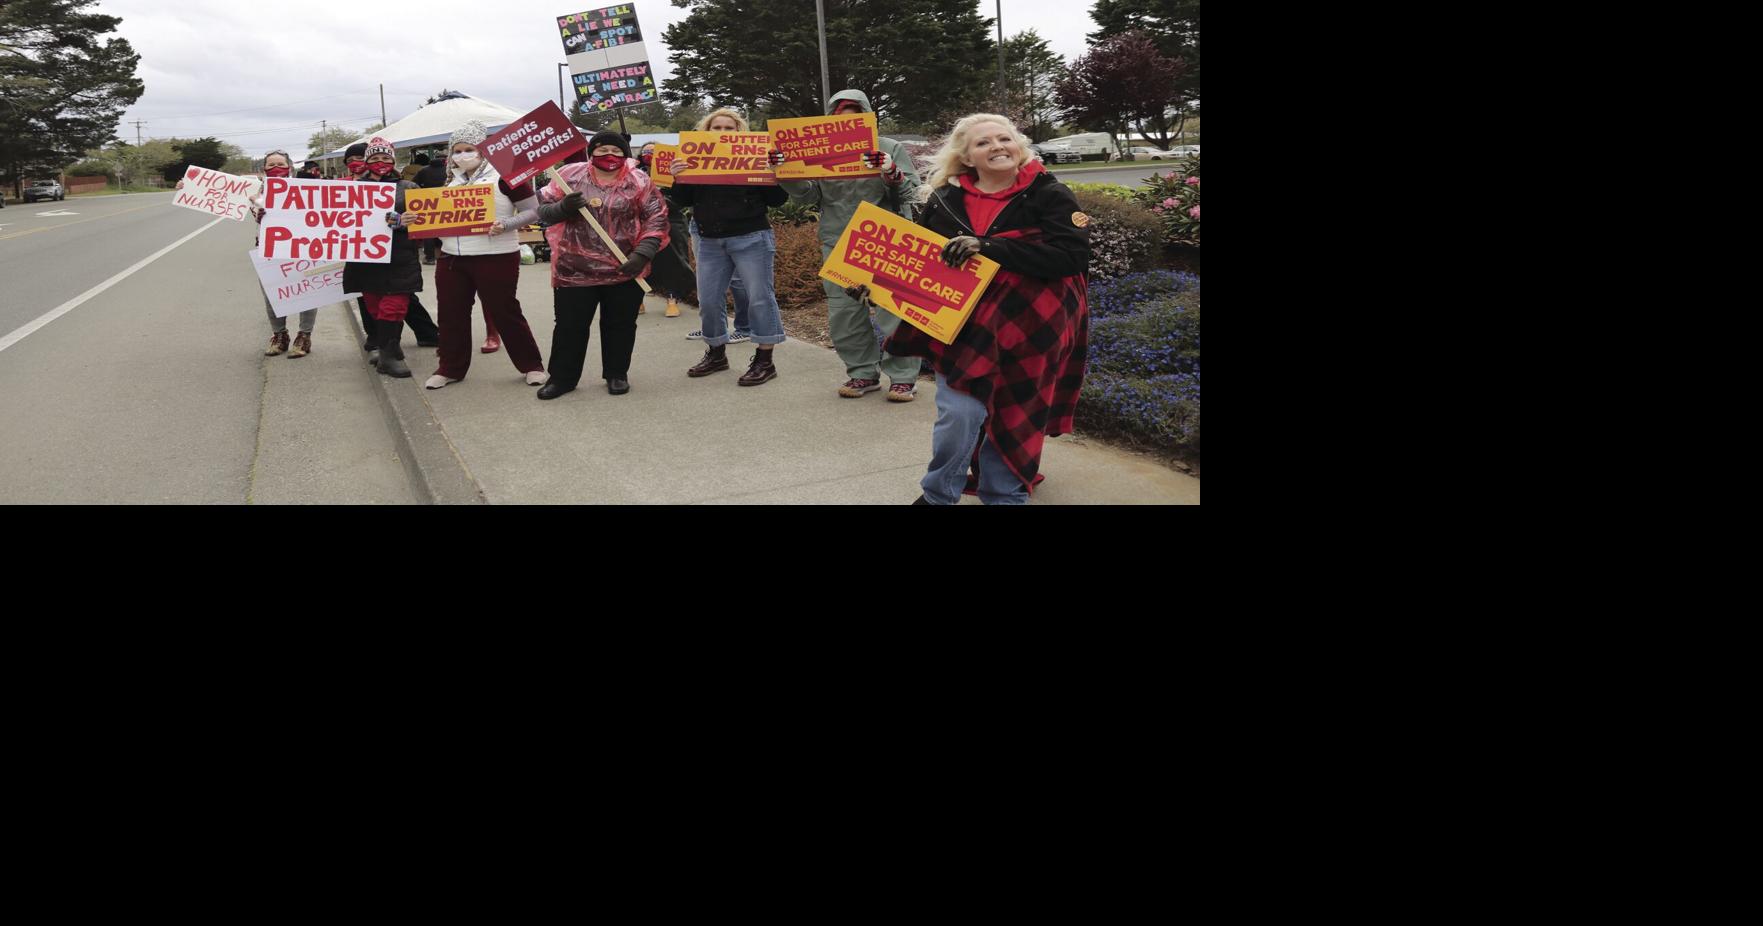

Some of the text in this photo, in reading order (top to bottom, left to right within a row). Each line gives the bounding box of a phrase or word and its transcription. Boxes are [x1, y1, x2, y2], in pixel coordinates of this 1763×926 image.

[599, 5, 630, 17] TELL
[562, 18, 620, 37] A LIE WE
[566, 26, 634, 47] CAN SPOT
[574, 65, 647, 84] ULTIMATELY
[578, 76, 652, 95] WE NEED A
[580, 88, 655, 113] FAIR CONTRACT
[487, 120, 539, 156] Patients
[775, 118, 865, 140] ON STRIKE
[511, 126, 555, 156] Before
[526, 128, 574, 162] Profits!
[681, 141, 716, 155] ON
[731, 144, 766, 156] RNs
[781, 137, 830, 151] FOR SAFE
[783, 140, 870, 159] PATIENT CARE
[658, 151, 676, 160] ON
[686, 156, 768, 171] STRIKE
[197, 168, 253, 197] HONK
[205, 188, 227, 200] FOR
[265, 178, 395, 210] PATIENTS
[442, 187, 491, 199] SUTTER
[178, 193, 247, 221] NURSES
[409, 198, 439, 211] ON
[453, 197, 484, 209] RNs
[305, 210, 373, 229] over
[414, 208, 487, 225] STRIKE
[263, 226, 391, 260] Profits
[859, 220, 982, 274] ON STRE
[855, 238, 925, 272] FOR SAFE
[280, 259, 327, 278] FO
[849, 250, 964, 305] PATIENT CARE
